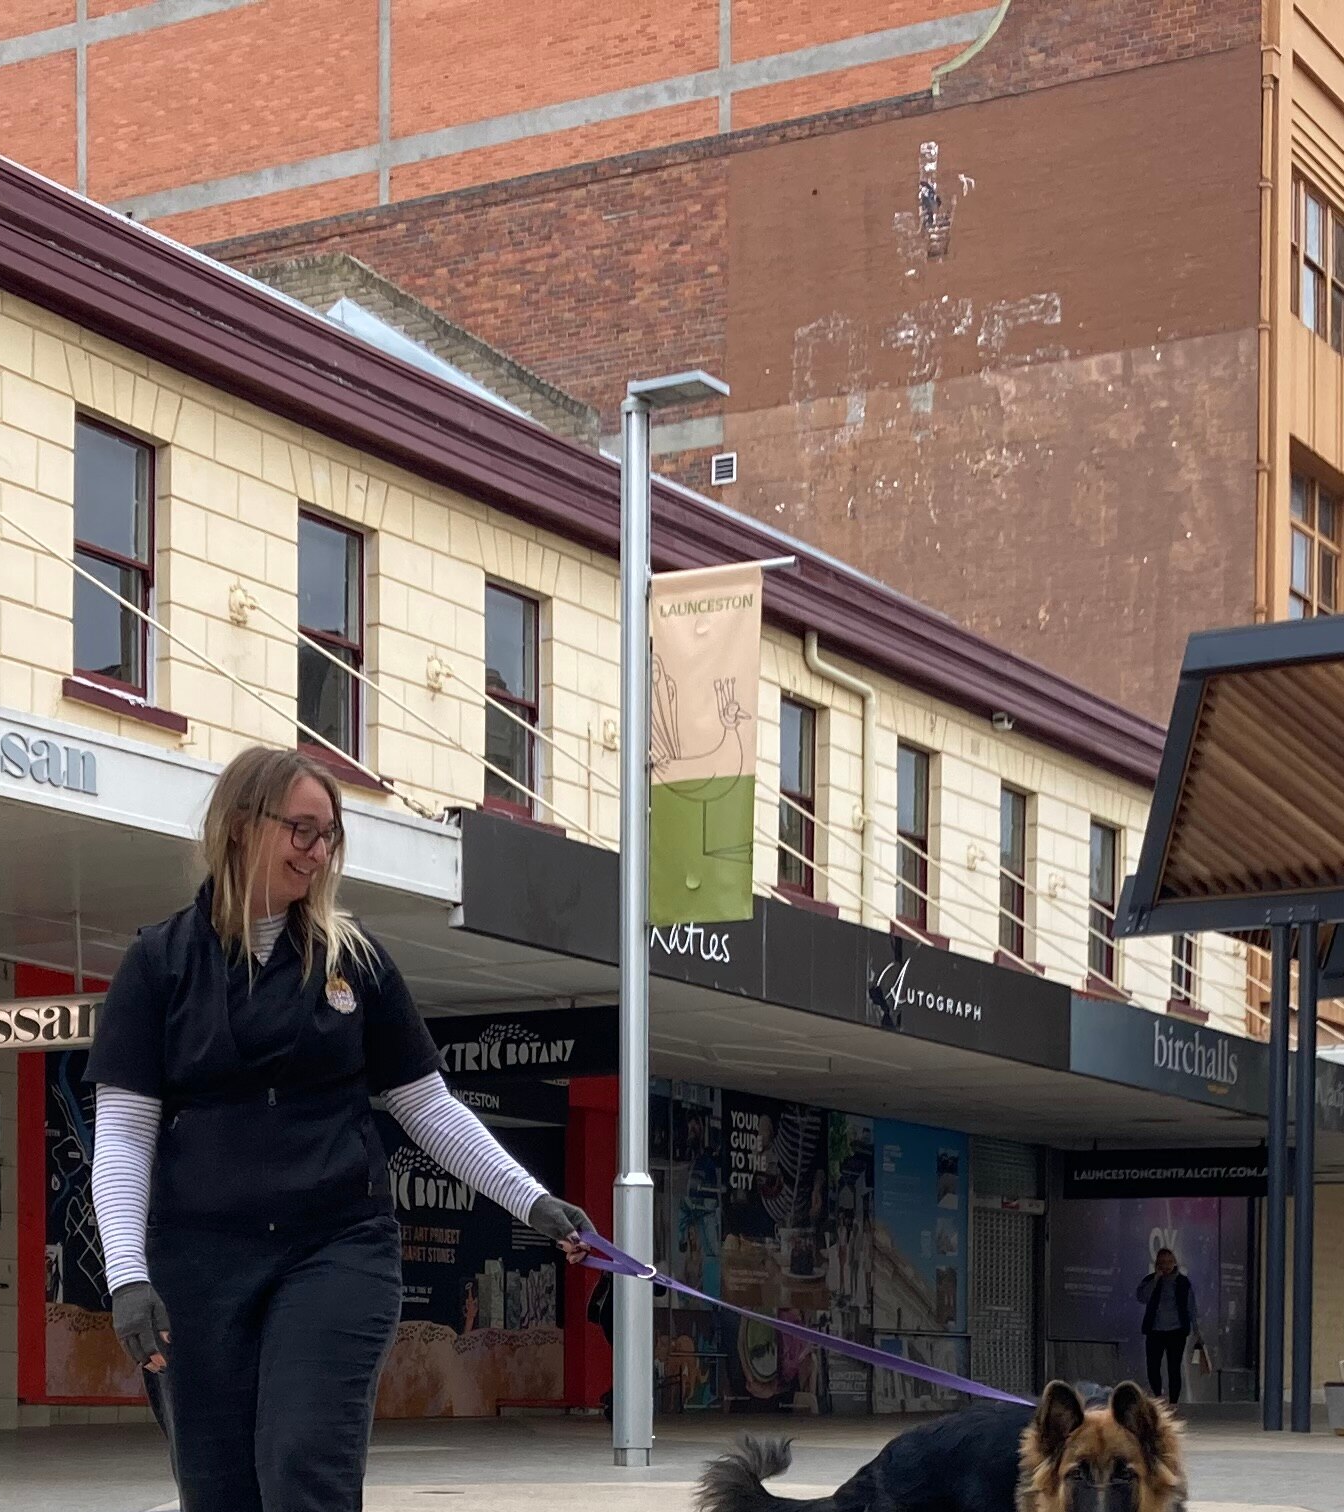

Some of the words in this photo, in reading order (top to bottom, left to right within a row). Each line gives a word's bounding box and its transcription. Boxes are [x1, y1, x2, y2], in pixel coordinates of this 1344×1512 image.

[659, 594, 754, 617] LAUNCESTON
[876, 957, 982, 1021] AUTOGRAPH
[506, 1039, 576, 1066] BOTANY
[1154, 1019, 1238, 1085] birchalls
[730, 1110, 759, 1131] YOUR
[730, 1131, 763, 1152] GUIDE
[730, 1151, 745, 1169] TO
[748, 1153, 767, 1172] THE
[729, 1172, 754, 1191] CITY
